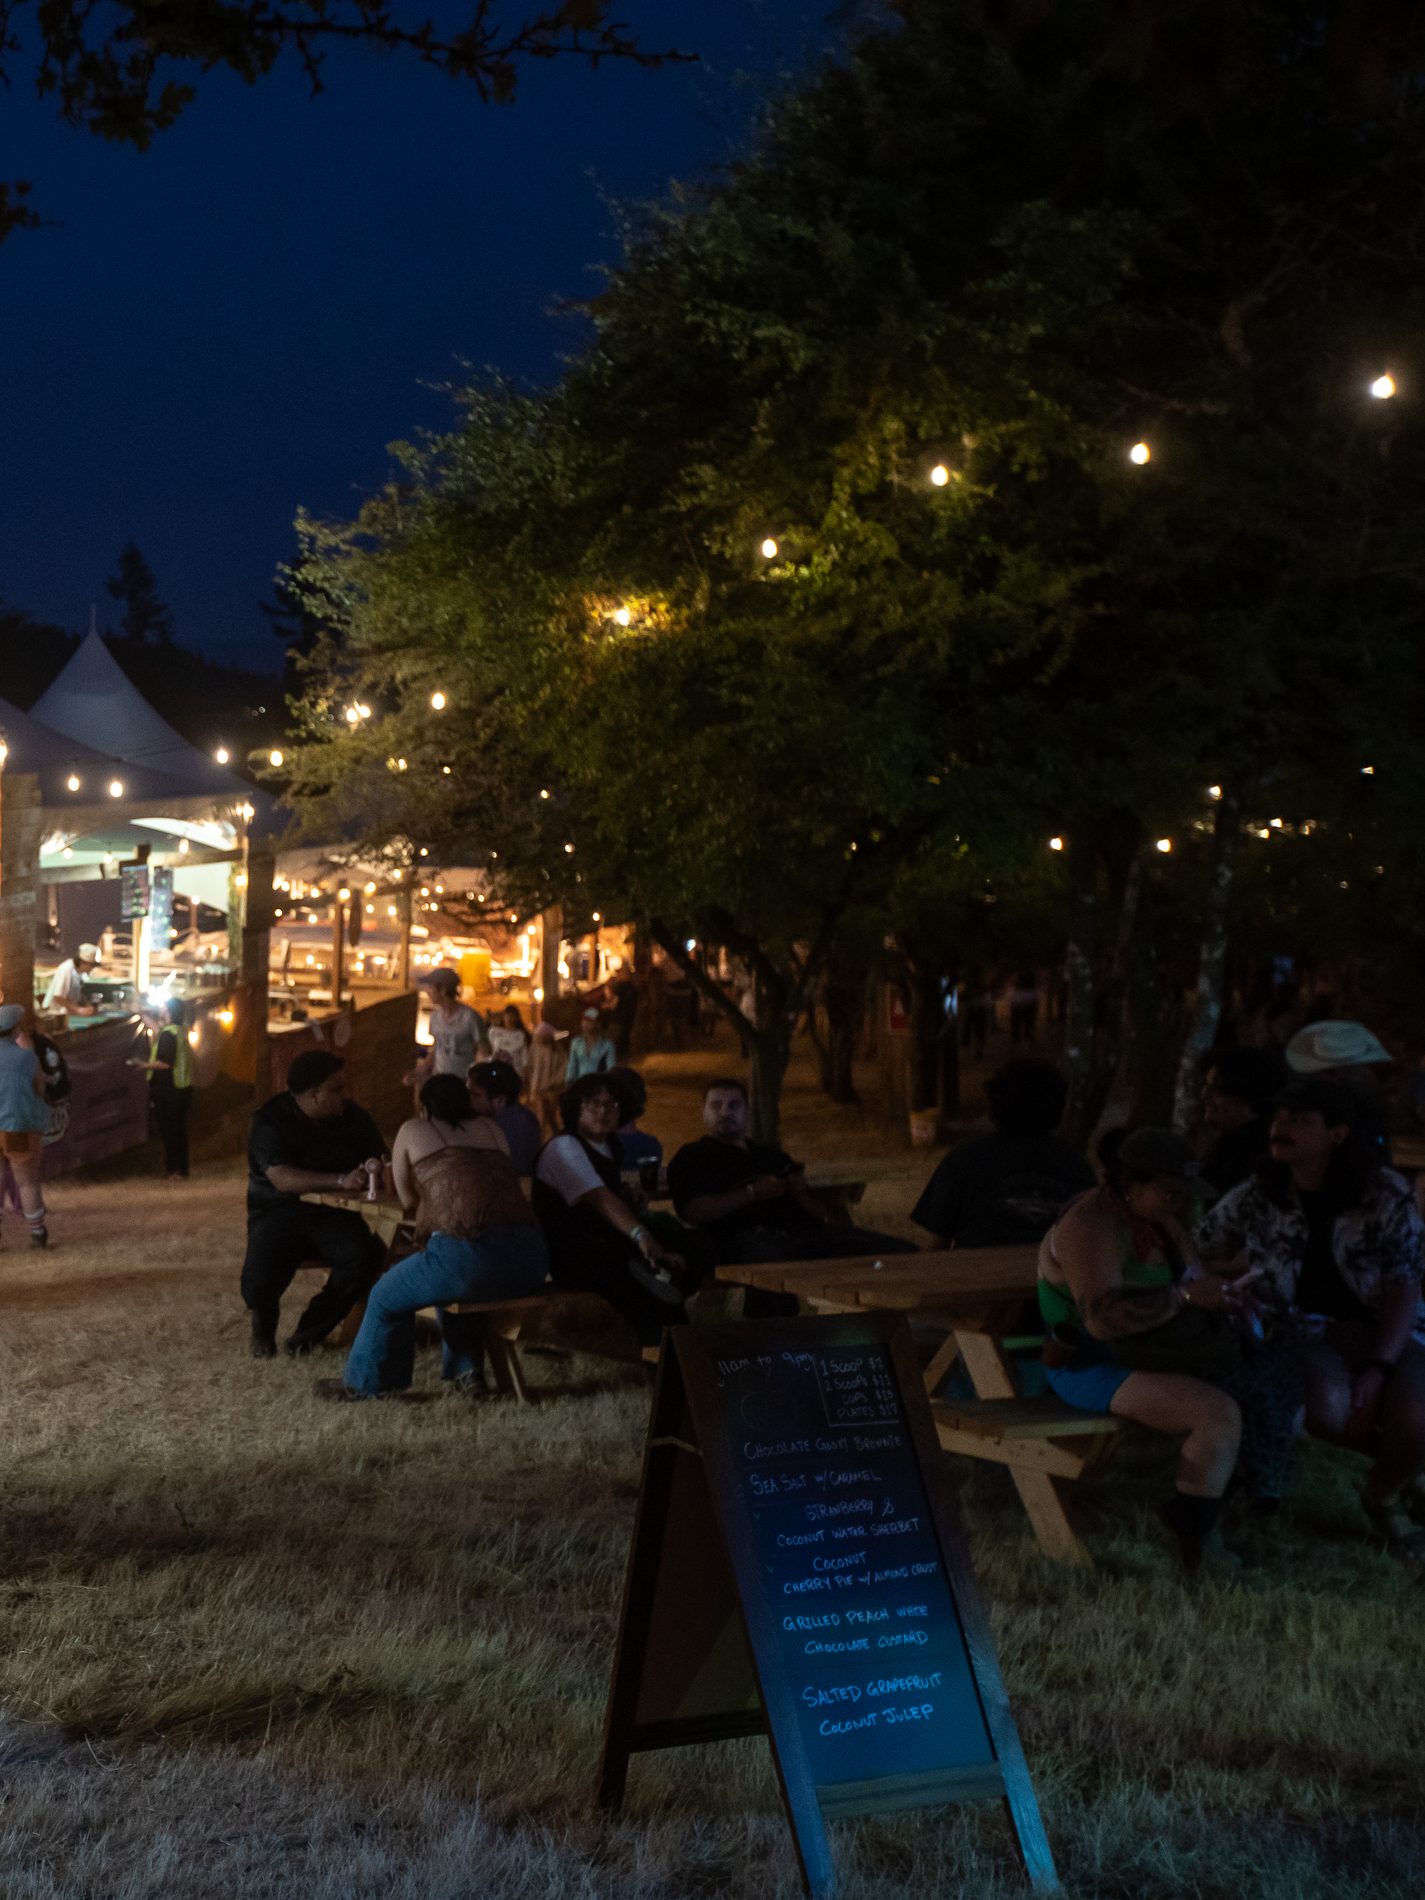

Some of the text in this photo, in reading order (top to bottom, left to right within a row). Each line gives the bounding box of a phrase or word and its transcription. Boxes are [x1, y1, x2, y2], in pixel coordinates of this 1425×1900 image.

[717, 1351, 815, 1376] 11am to 9pm
[820, 1359, 830, 1377] 1
[830, 1357, 863, 1374] SCOOP
[825, 1379, 833, 1392] 2
[834, 1375, 868, 1390] SCOOPS
[836, 1405, 875, 1419] PLATES
[743, 1440, 812, 1460] CHOCOLATE
[853, 1434, 903, 1452] BROWNIE
[750, 1474, 779, 1496] SEA
[781, 1474, 808, 1492] SALT
[806, 1499, 874, 1521] STRAWBERRY
[777, 1517, 920, 1548] COCONUT WATER SHERBET
[813, 1551, 868, 1573] COCONUT
[783, 1577, 832, 1595] CHERRY
[834, 1574, 854, 1588] PIE
[874, 1566, 909, 1584] ALMOND
[911, 1562, 938, 1577] CRUST
[782, 1613, 841, 1632] GRILLED
[845, 1607, 890, 1626] PEACH
[804, 1630, 929, 1655] CHOCOLATE CUSTARD
[802, 1672, 942, 1708] SALTED GRAPEFRUIT
[819, 1703, 934, 1736] COCONUT JULEP
